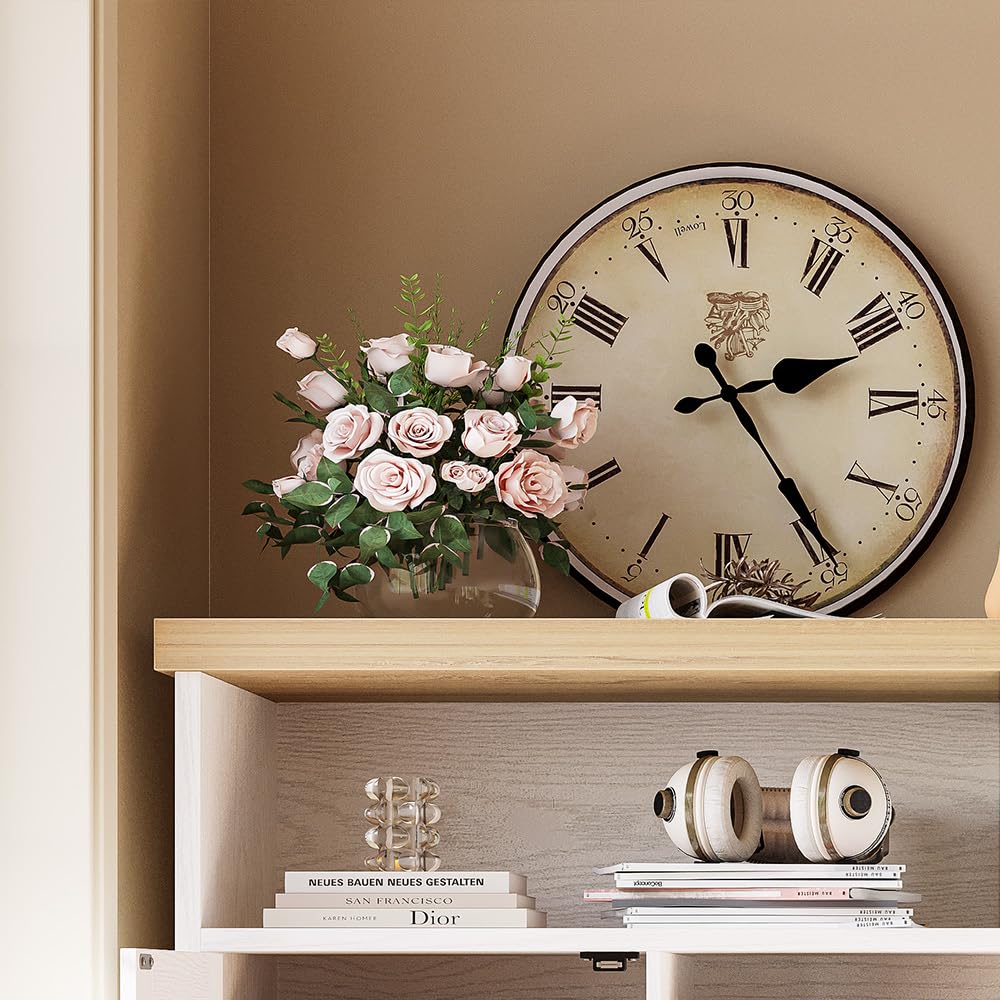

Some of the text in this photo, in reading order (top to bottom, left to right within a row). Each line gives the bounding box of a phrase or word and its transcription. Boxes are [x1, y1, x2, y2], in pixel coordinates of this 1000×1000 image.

[721, 190, 755, 211] 30
[621, 207, 654, 241] 25
[673, 221, 707, 237] Lowell
[824, 216, 859, 244] 35
[721, 218, 750, 268] VI
[800, 236, 846, 299] VII
[547, 281, 576, 314] 20
[898, 290, 926, 320] 40
[846, 291, 904, 354] VIII
[868, 387, 920, 420] IX
[927, 389, 948, 421] 45
[895, 487, 923, 522] 50
[620, 563, 643, 582] 5
[308, 877, 484, 887] NEUES BAUEN NEUES GESTALTEN
[345, 896, 453, 905] SAN FRANCISCO
[410, 909, 461, 926] Dior
